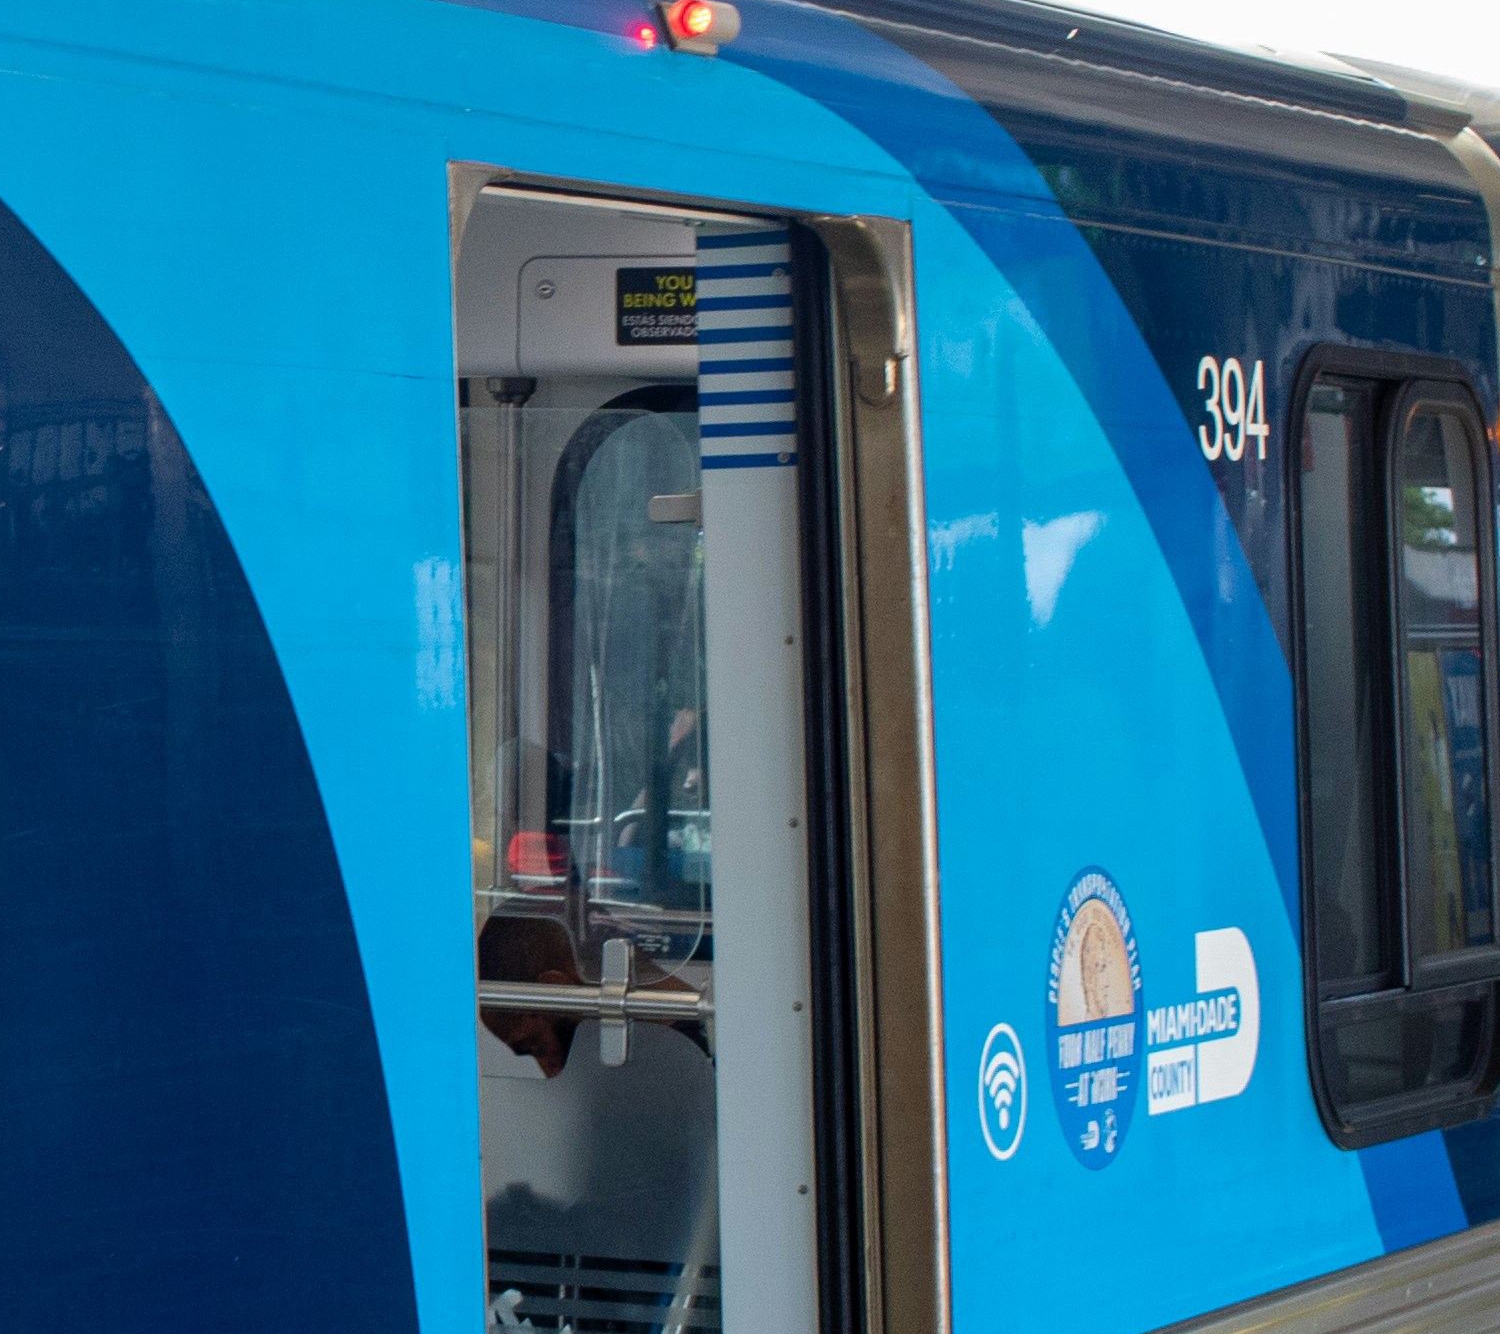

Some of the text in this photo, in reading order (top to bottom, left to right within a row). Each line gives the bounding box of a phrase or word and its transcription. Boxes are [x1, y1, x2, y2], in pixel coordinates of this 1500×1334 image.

[655, 275, 694, 290] YOU
[623, 293, 677, 308] BEING
[622, 312, 656, 326] ESTÁS
[1197, 355, 1270, 461] 394
[1150, 1060, 1192, 1100] COUNTY
